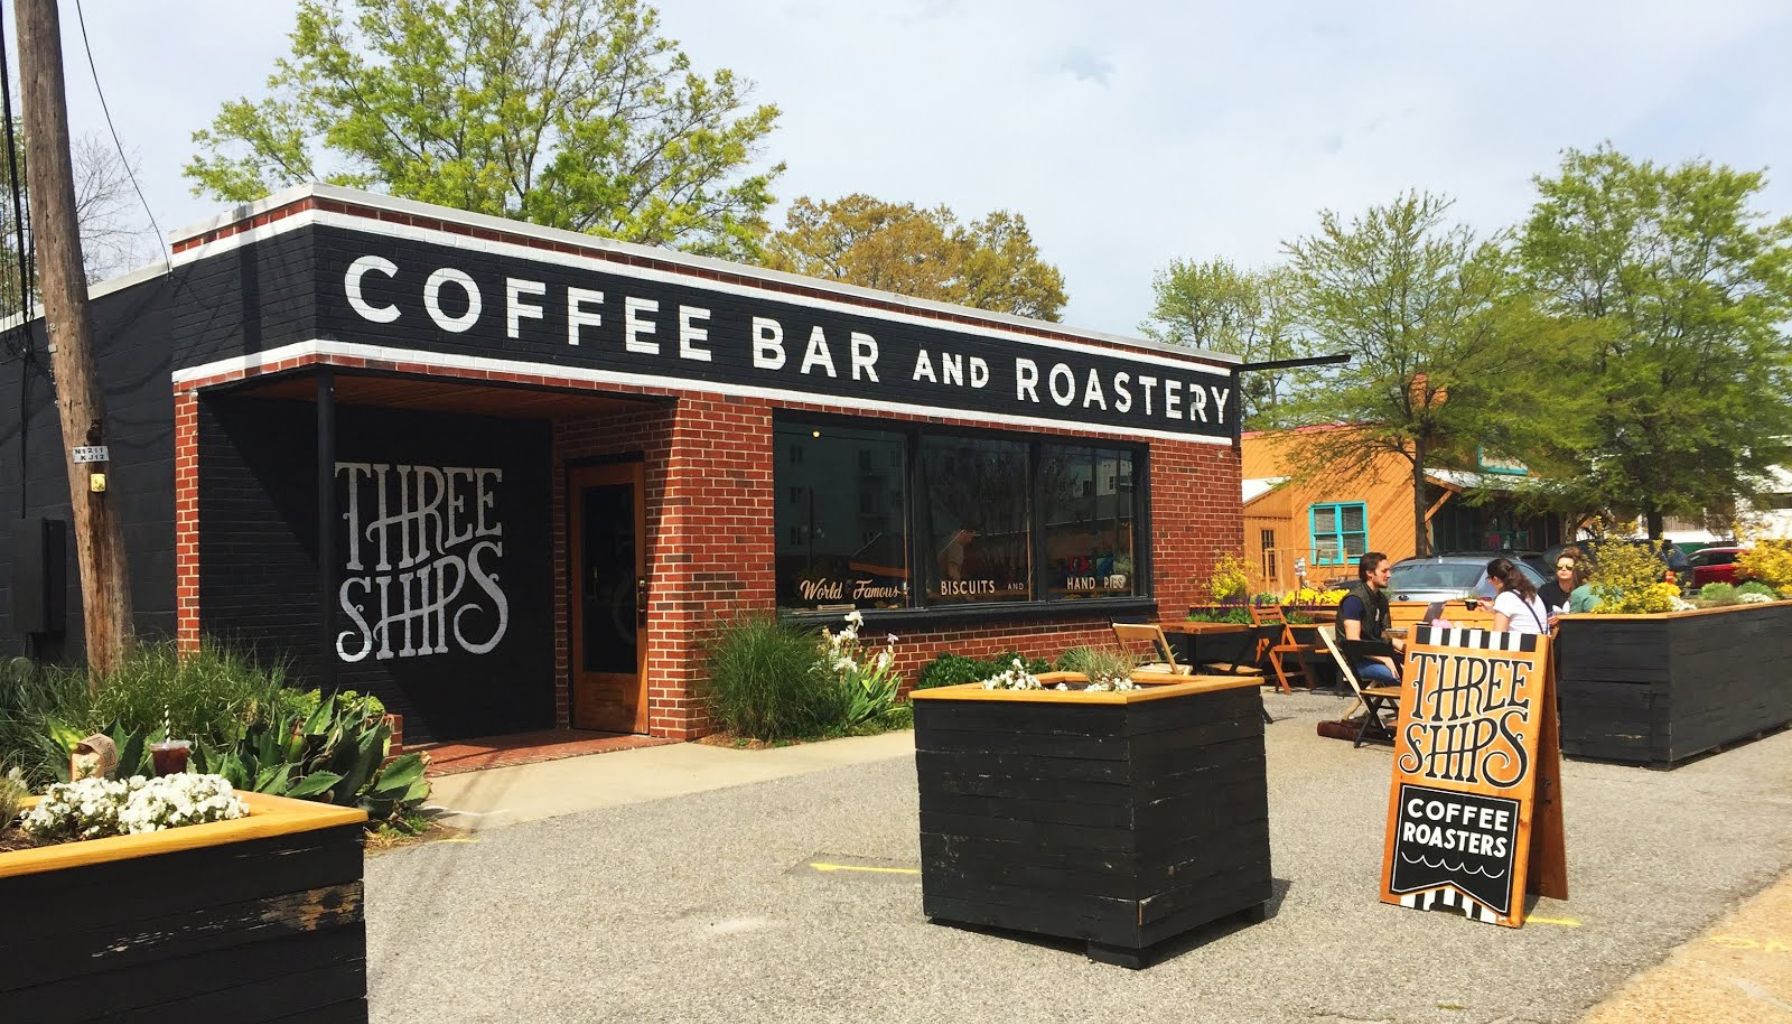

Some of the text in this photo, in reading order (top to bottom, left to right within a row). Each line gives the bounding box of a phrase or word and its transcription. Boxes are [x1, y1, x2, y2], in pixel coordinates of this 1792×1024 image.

[344, 255, 1230, 424] COFFEE BAR AND ROASTERY
[334, 462, 502, 571] THREE
[336, 541, 508, 662] SHIPS
[800, 577, 843, 600] World
[853, 578, 901, 600] Famous
[941, 579, 996, 595] BISCUITS
[1007, 583, 1024, 591] AND
[1067, 577, 1096, 590] HAND
[1411, 652, 1533, 722] THREE
[1399, 709, 1528, 788] SHIPS
[1403, 822, 1507, 858] ROASTERS
[1407, 798, 1510, 832] COFFEE
